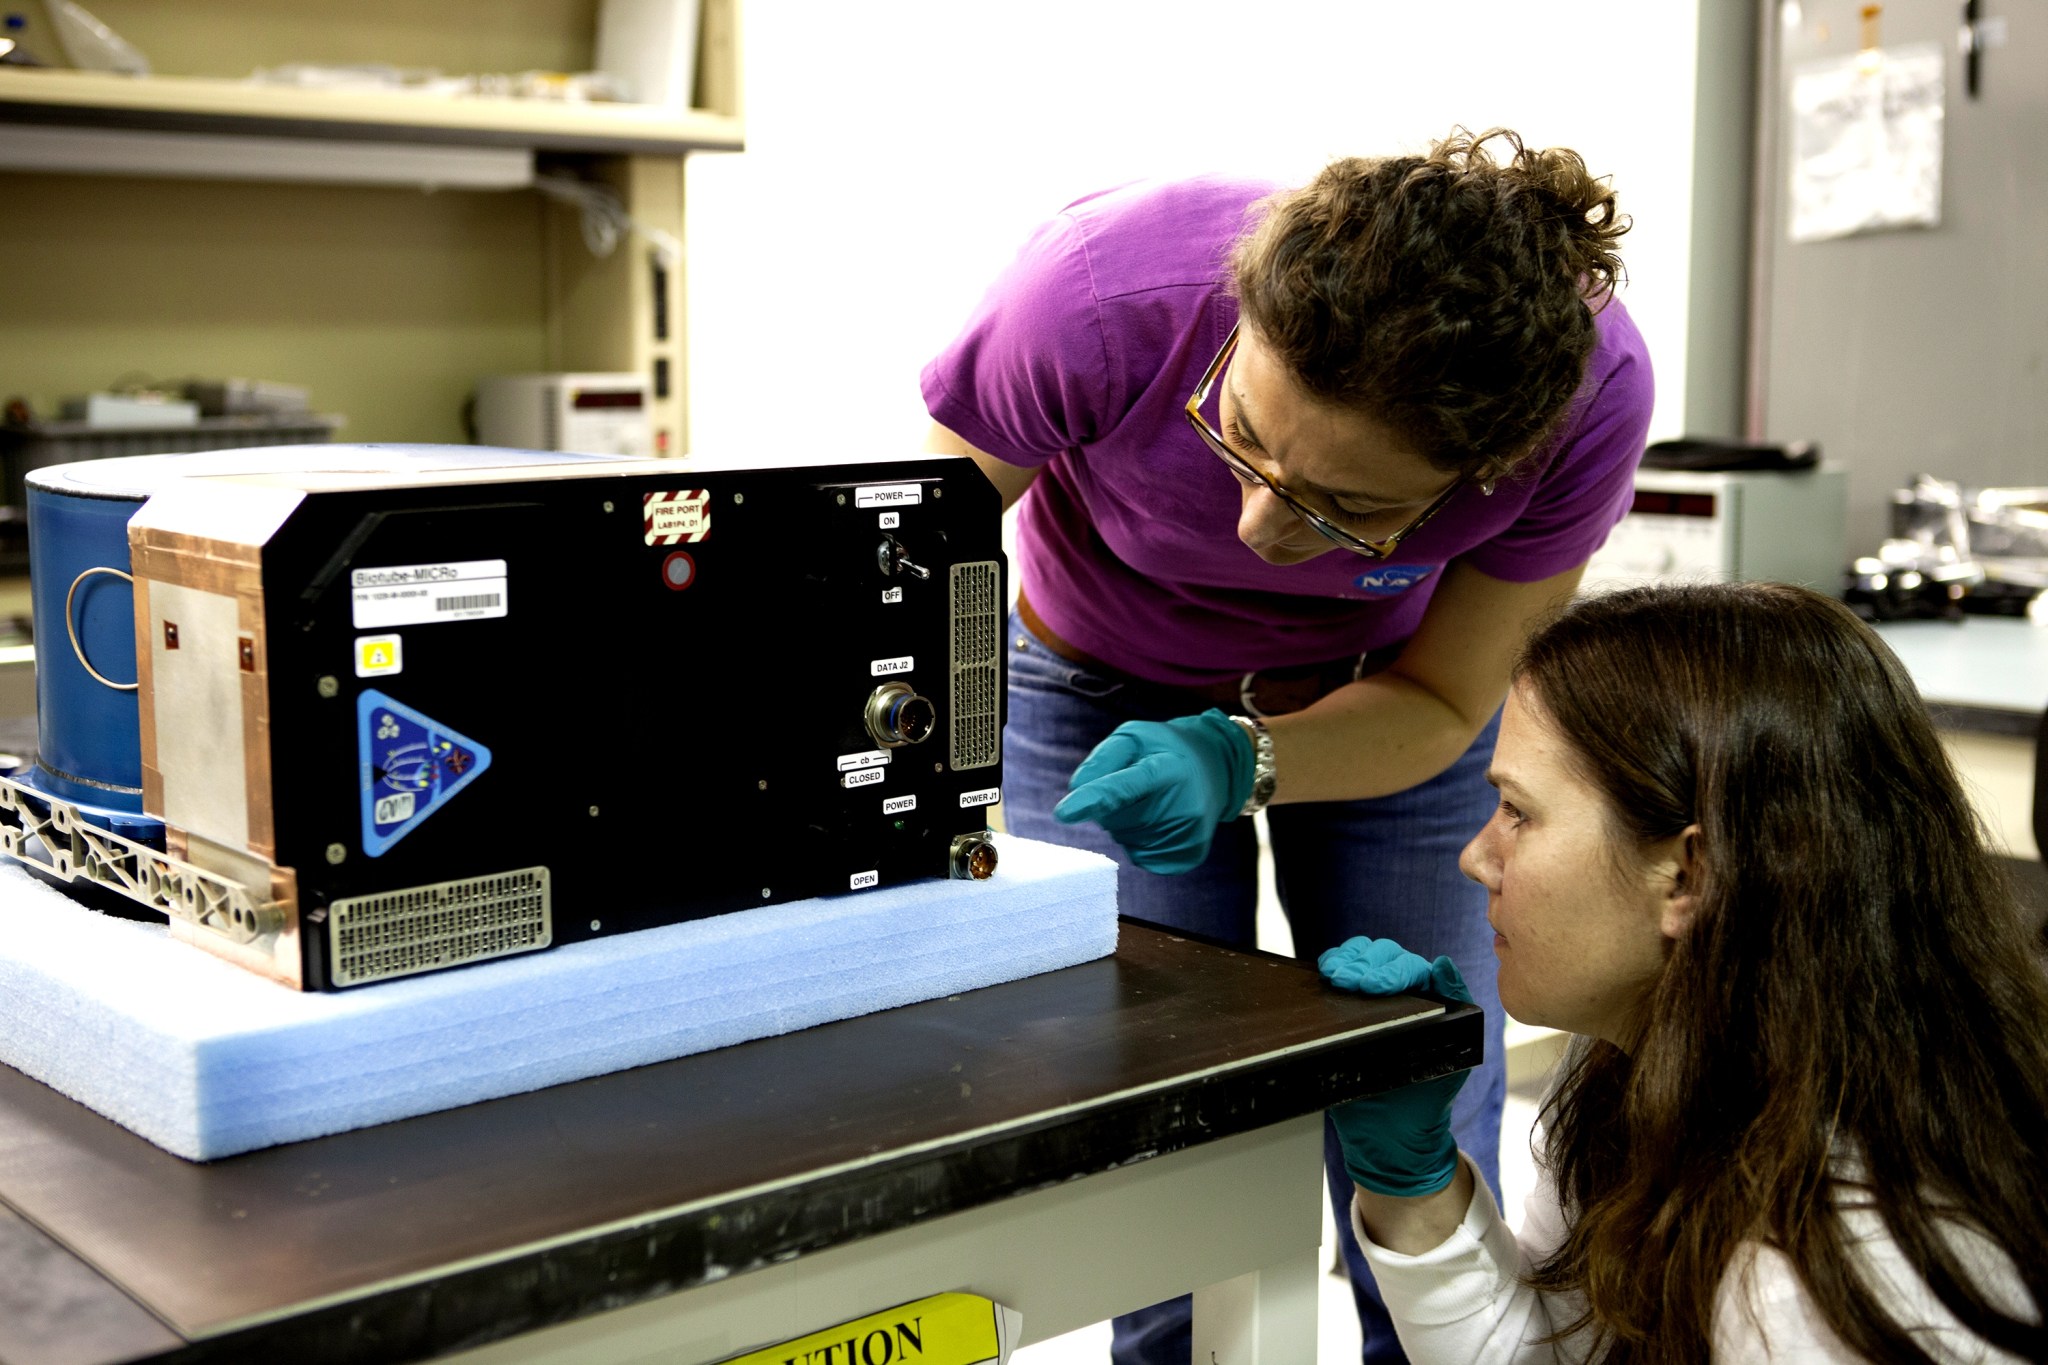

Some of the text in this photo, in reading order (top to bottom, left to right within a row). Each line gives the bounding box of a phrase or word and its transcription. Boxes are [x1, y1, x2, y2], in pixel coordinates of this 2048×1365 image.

[874, 491, 904, 501] POWER
[655, 505, 700, 516] FIRE PORT
[884, 517, 896, 526] ON
[884, 591, 900, 600] OFF
[877, 661, 909, 673] DATA J2
[860, 756, 870, 766] cb
[849, 771, 881, 785] CLOSED
[962, 791, 998, 804] POWER J1
[885, 799, 914, 811] POWER
[854, 875, 875, 886] OPEN
